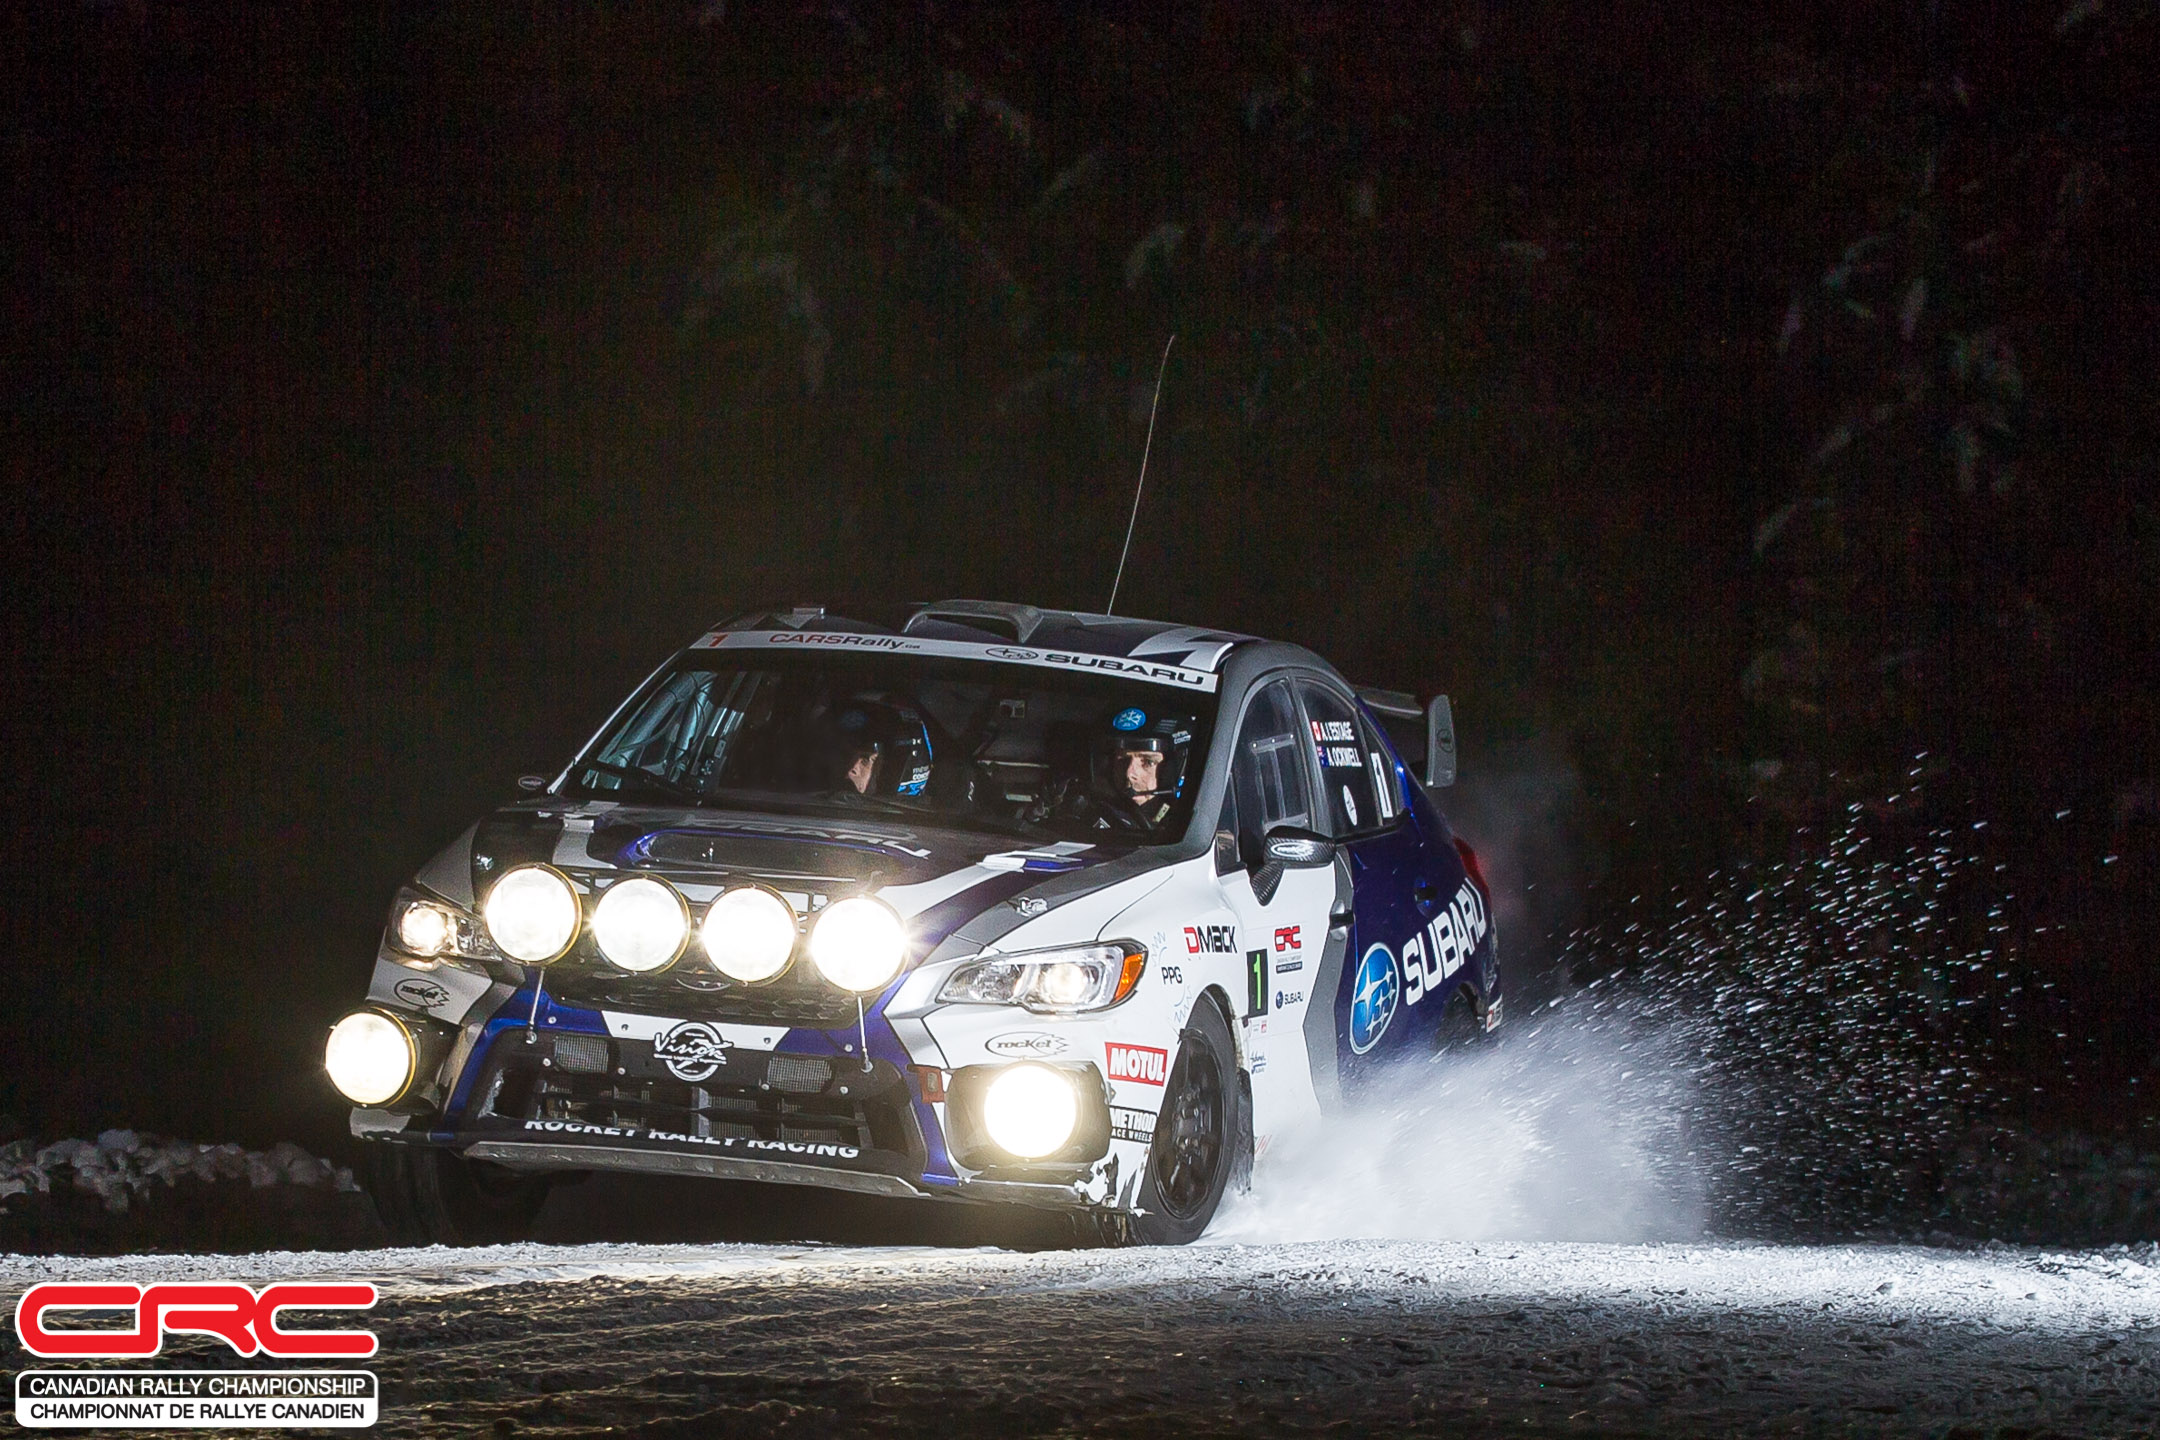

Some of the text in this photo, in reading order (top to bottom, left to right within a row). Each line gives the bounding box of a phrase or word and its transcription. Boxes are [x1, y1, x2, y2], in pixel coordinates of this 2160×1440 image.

[709, 634, 729, 647] 1
[1044, 653, 1204, 686] SUBARU
[1275, 926, 1302, 952] CRC
[1402, 877, 1487, 1006] SUBARU
[1161, 966, 1183, 984] PPG
[1254, 953, 1262, 1010] 1
[1109, 1049, 1165, 1082] MOTUL
[1111, 1128, 1126, 1138] ACE
